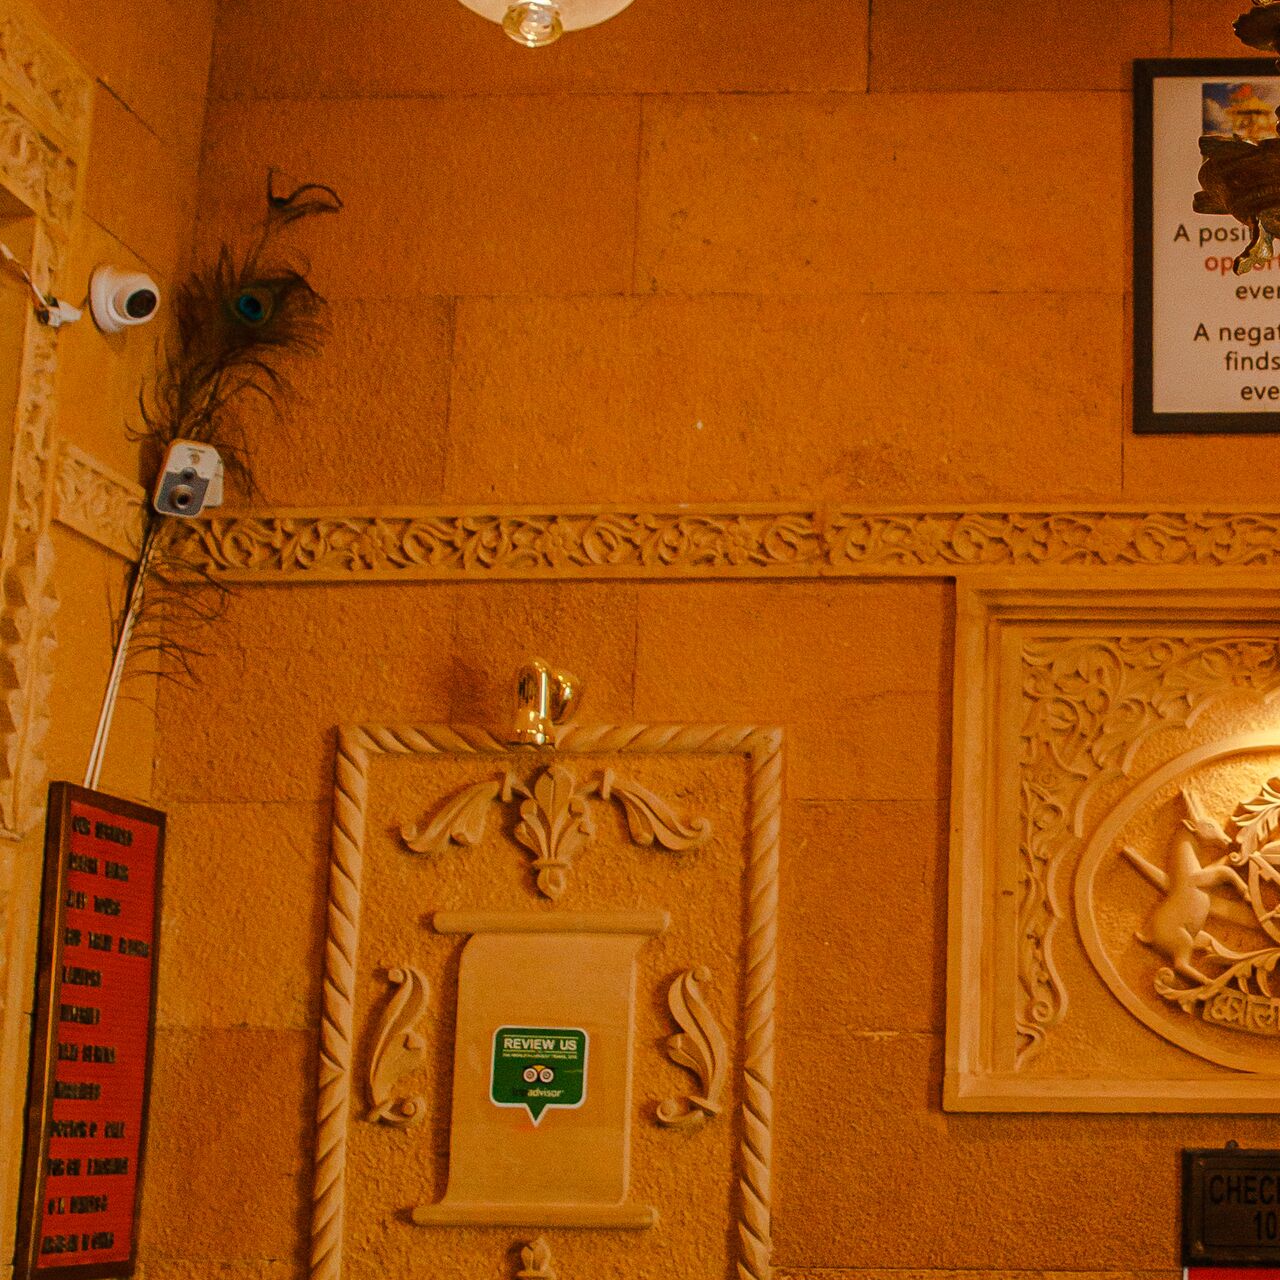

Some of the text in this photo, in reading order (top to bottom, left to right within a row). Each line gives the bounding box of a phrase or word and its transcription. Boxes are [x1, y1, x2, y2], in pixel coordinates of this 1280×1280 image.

[1174, 224, 1190, 241] A
[1200, 223, 1253, 247] posi
[1194, 323, 1209, 341] A
[1225, 351, 1280, 371] finds
[503, 1038, 577, 1051] REVIEW US
